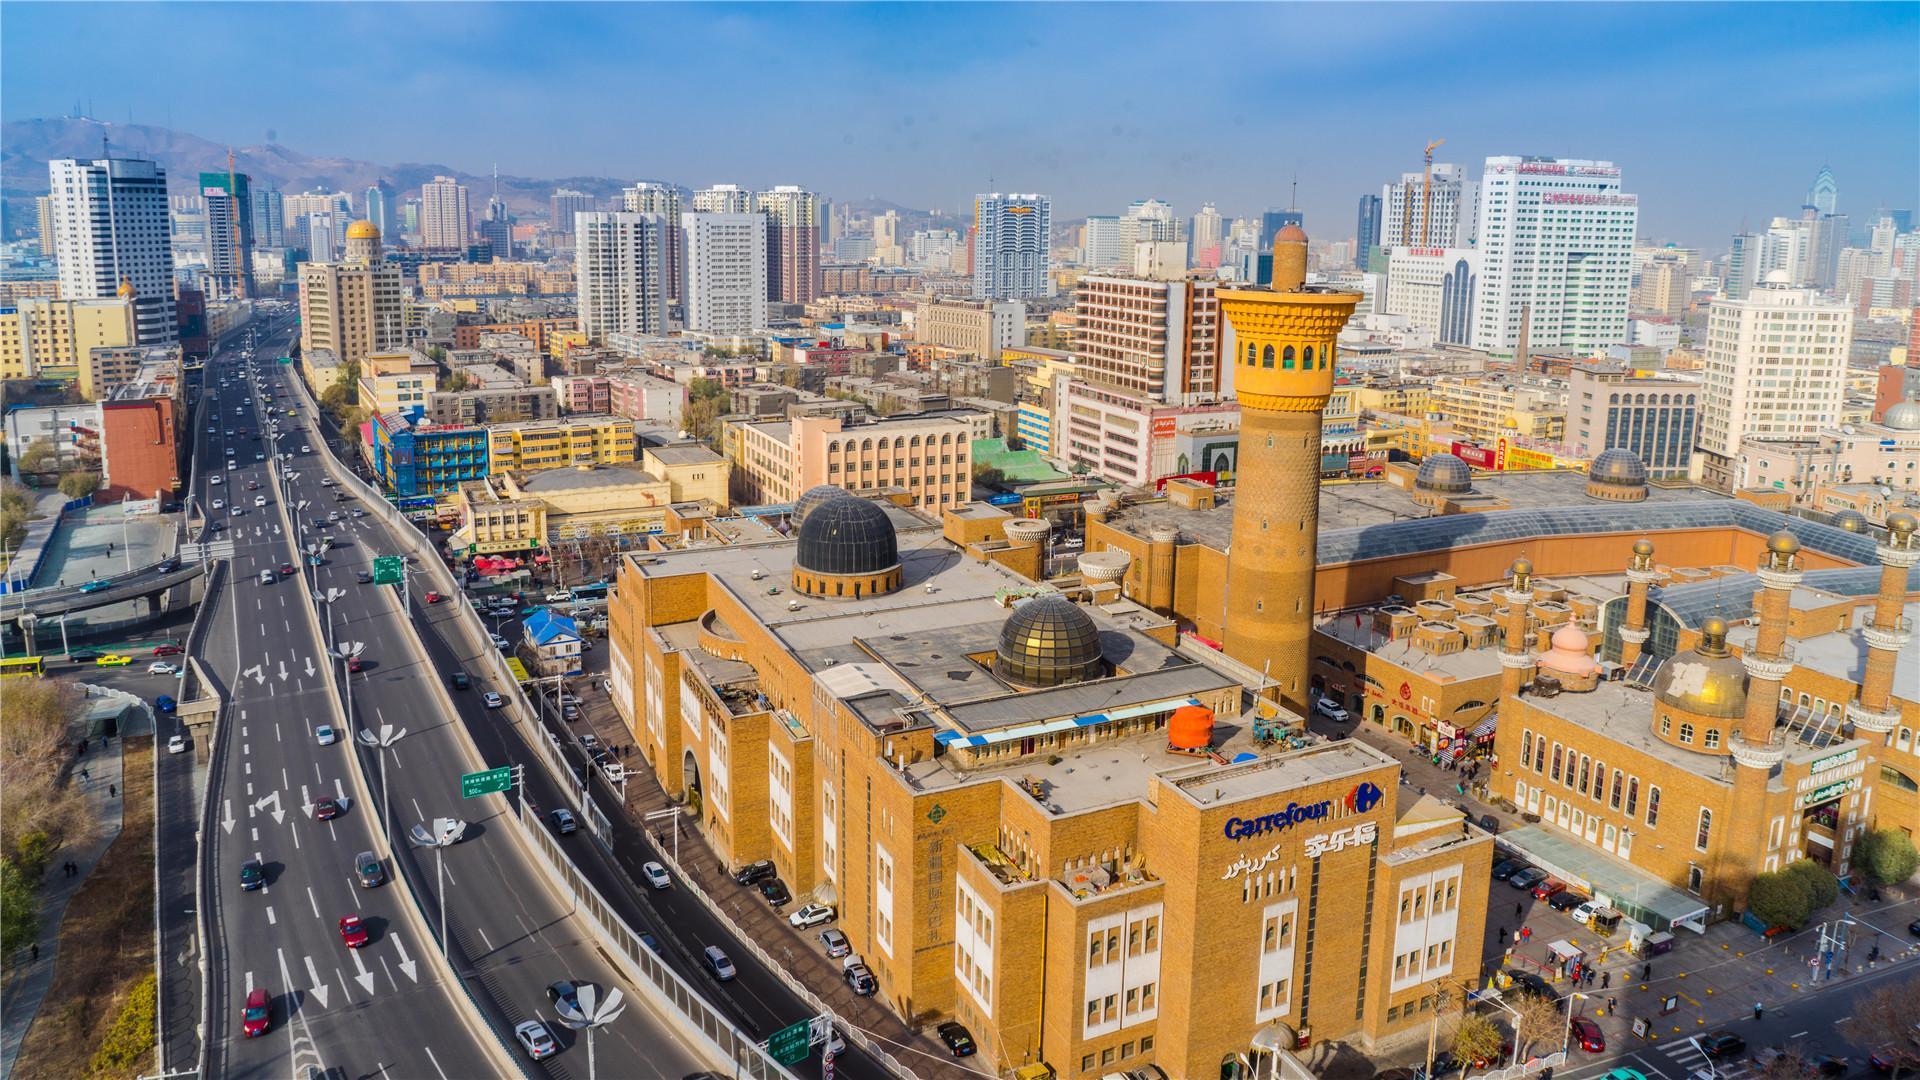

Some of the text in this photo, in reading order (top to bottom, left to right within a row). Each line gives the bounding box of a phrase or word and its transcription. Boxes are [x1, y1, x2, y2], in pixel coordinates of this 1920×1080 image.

[1225, 800, 1331, 839] Carrefour
[1304, 821, 1376, 858] 家乐福
[928, 839, 943, 942] 新疆国际大巴扎
